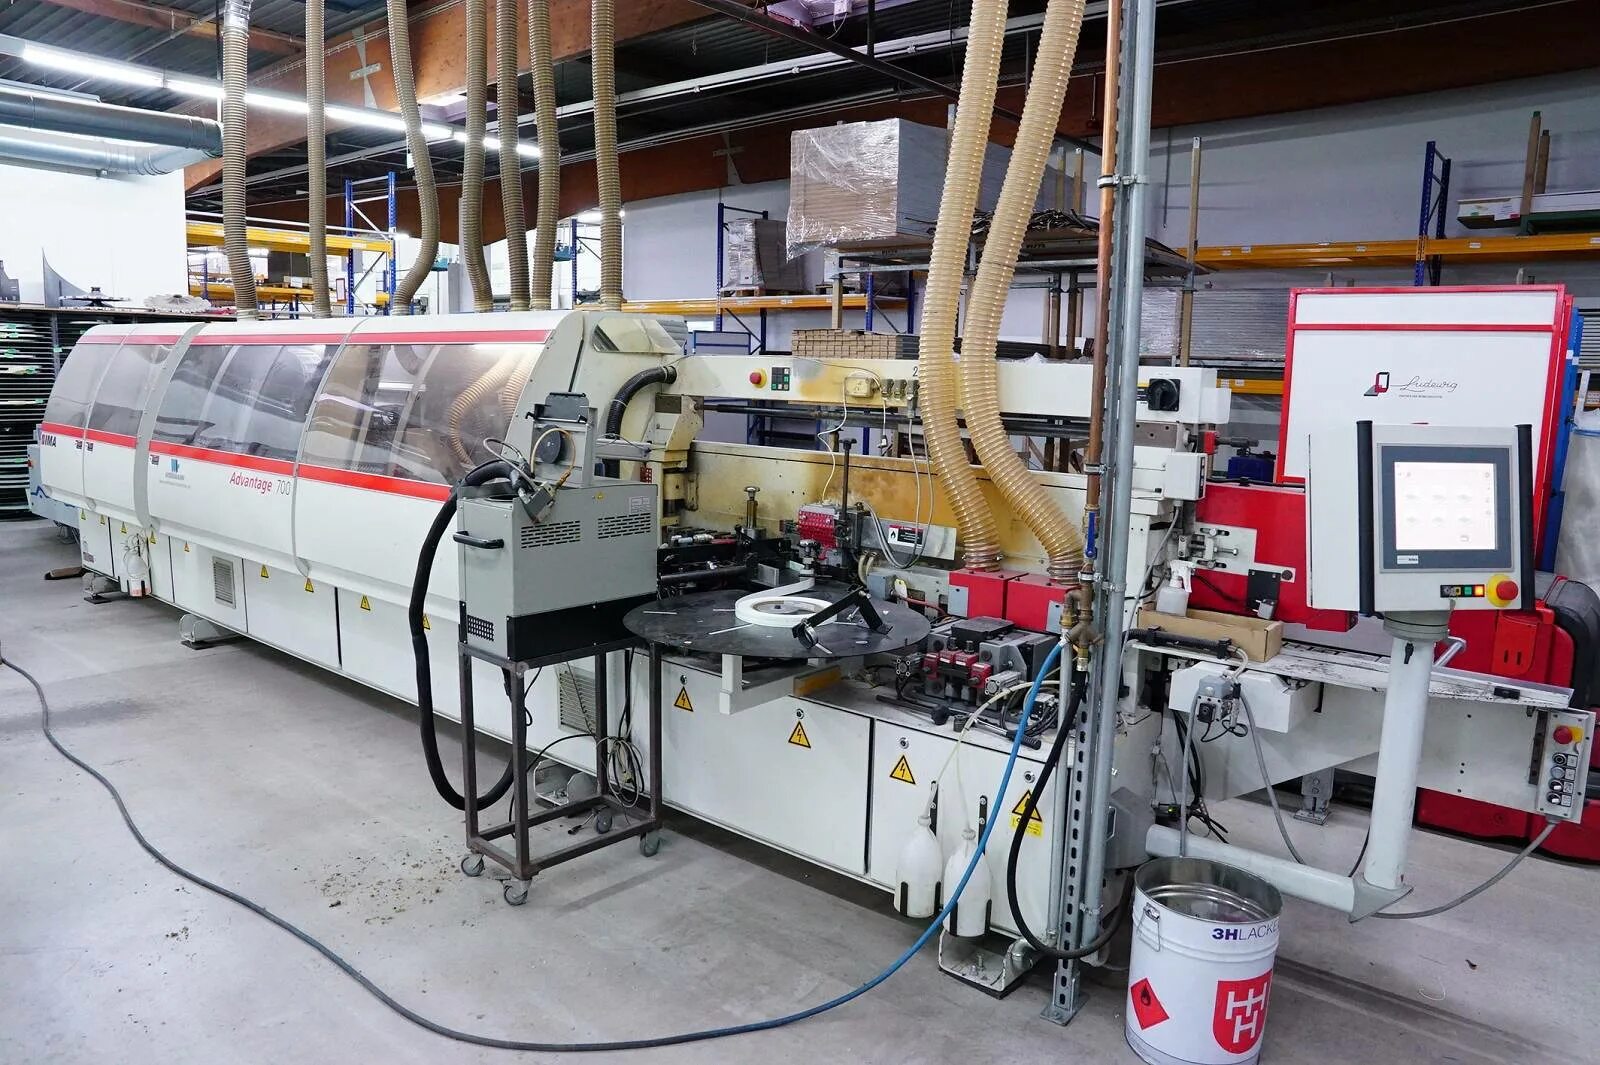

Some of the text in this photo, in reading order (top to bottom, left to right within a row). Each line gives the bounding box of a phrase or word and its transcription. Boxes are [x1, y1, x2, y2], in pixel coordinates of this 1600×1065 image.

[912, 366, 918, 376] 2
[1400, 376, 1457, 392] Ludewig
[229, 471, 291, 495] Advantage 700
